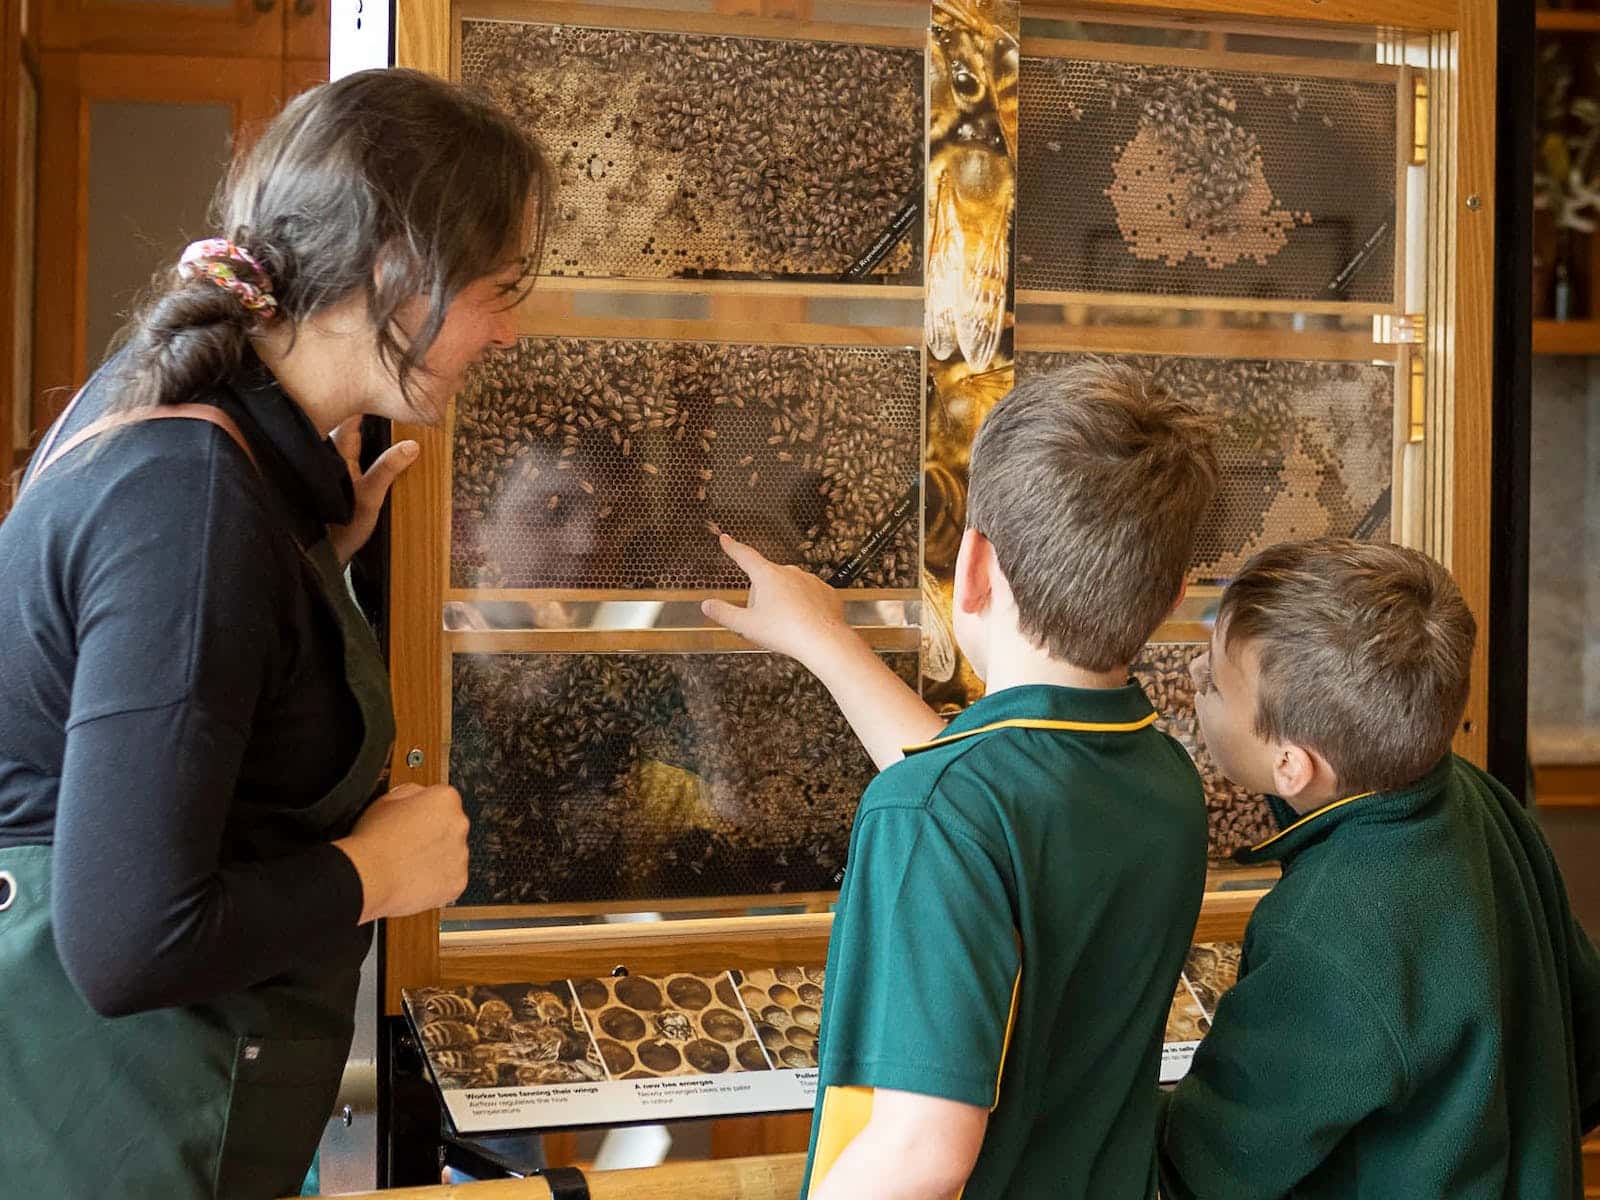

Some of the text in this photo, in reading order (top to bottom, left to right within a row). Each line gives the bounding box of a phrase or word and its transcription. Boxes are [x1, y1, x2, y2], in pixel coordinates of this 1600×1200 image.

[679, 1079, 714, 1087] emerges
[519, 1089, 551, 1098] fanning
[573, 1087, 599, 1095] wings
